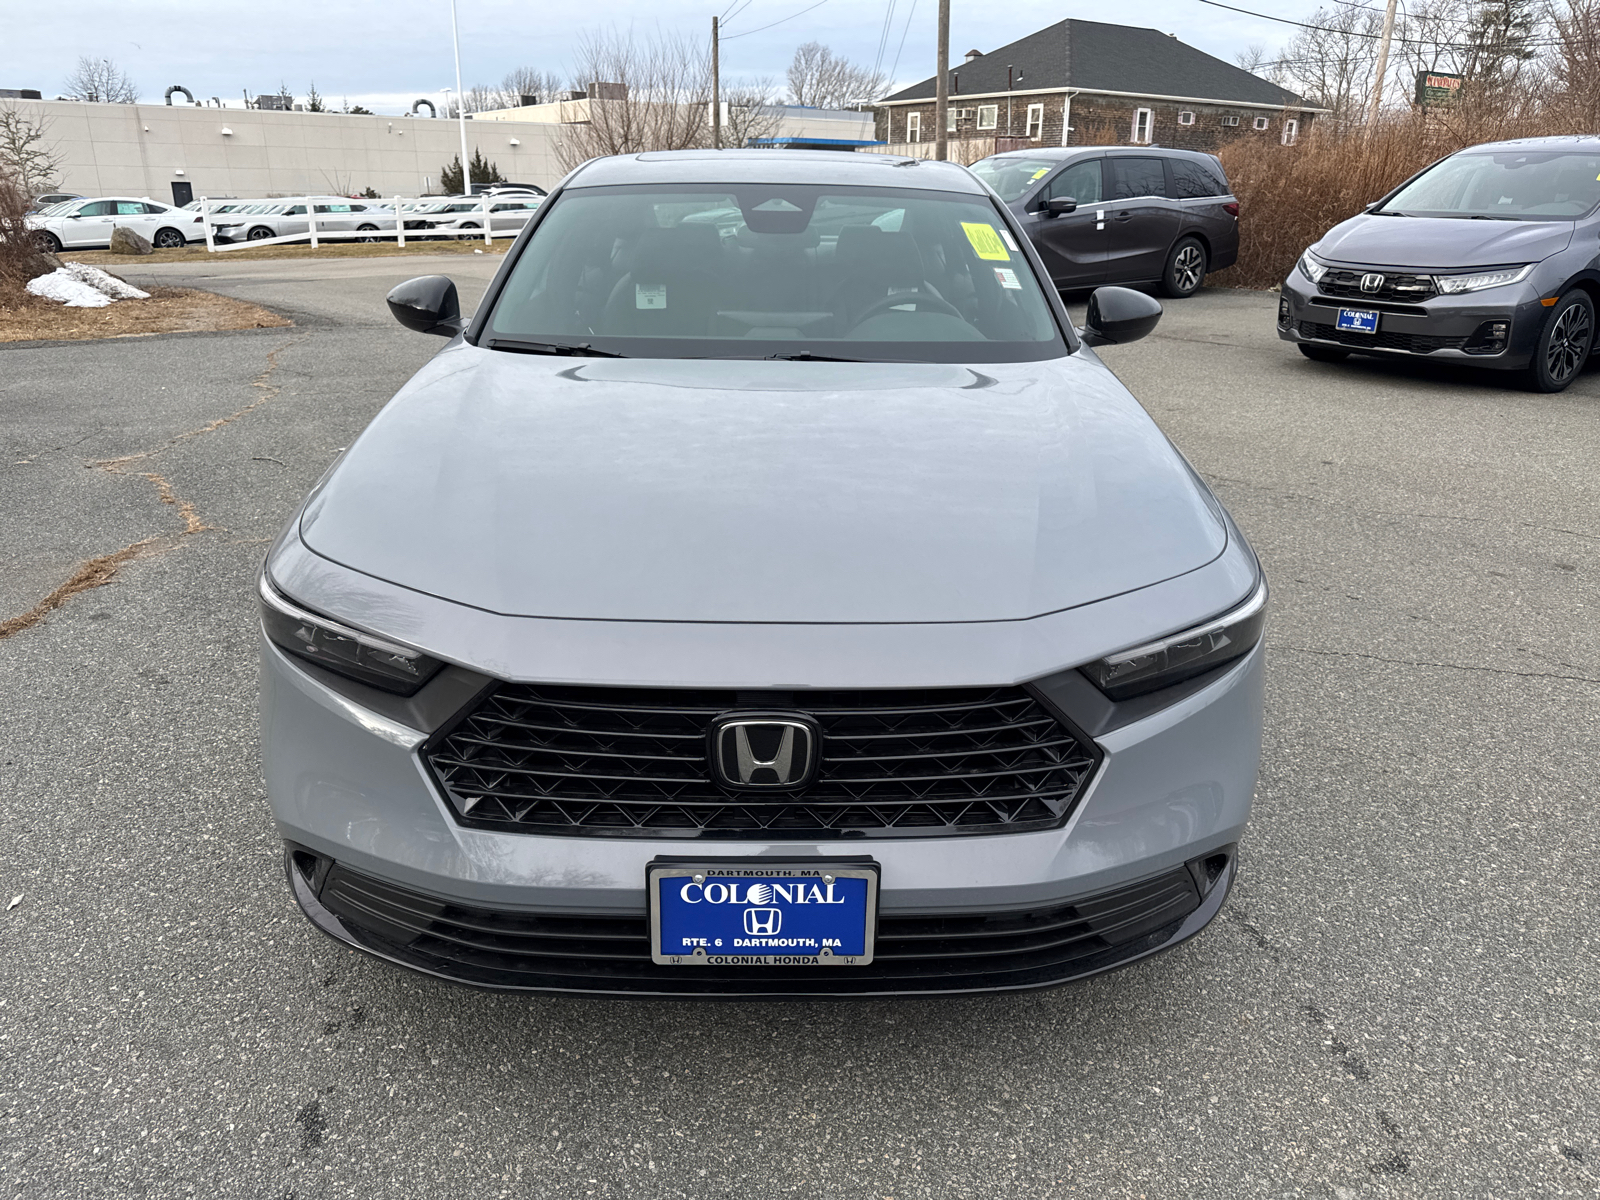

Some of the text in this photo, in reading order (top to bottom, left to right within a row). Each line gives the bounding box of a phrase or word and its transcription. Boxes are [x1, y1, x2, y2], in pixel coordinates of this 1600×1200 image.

[1343, 311, 1374, 320] COLONIAL
[680, 883, 845, 905] COLONIAL
[682, 938, 842, 948] RTE. 6 DARTMOUTH, MA
[706, 956, 819, 965] COLONIAL HONDA
